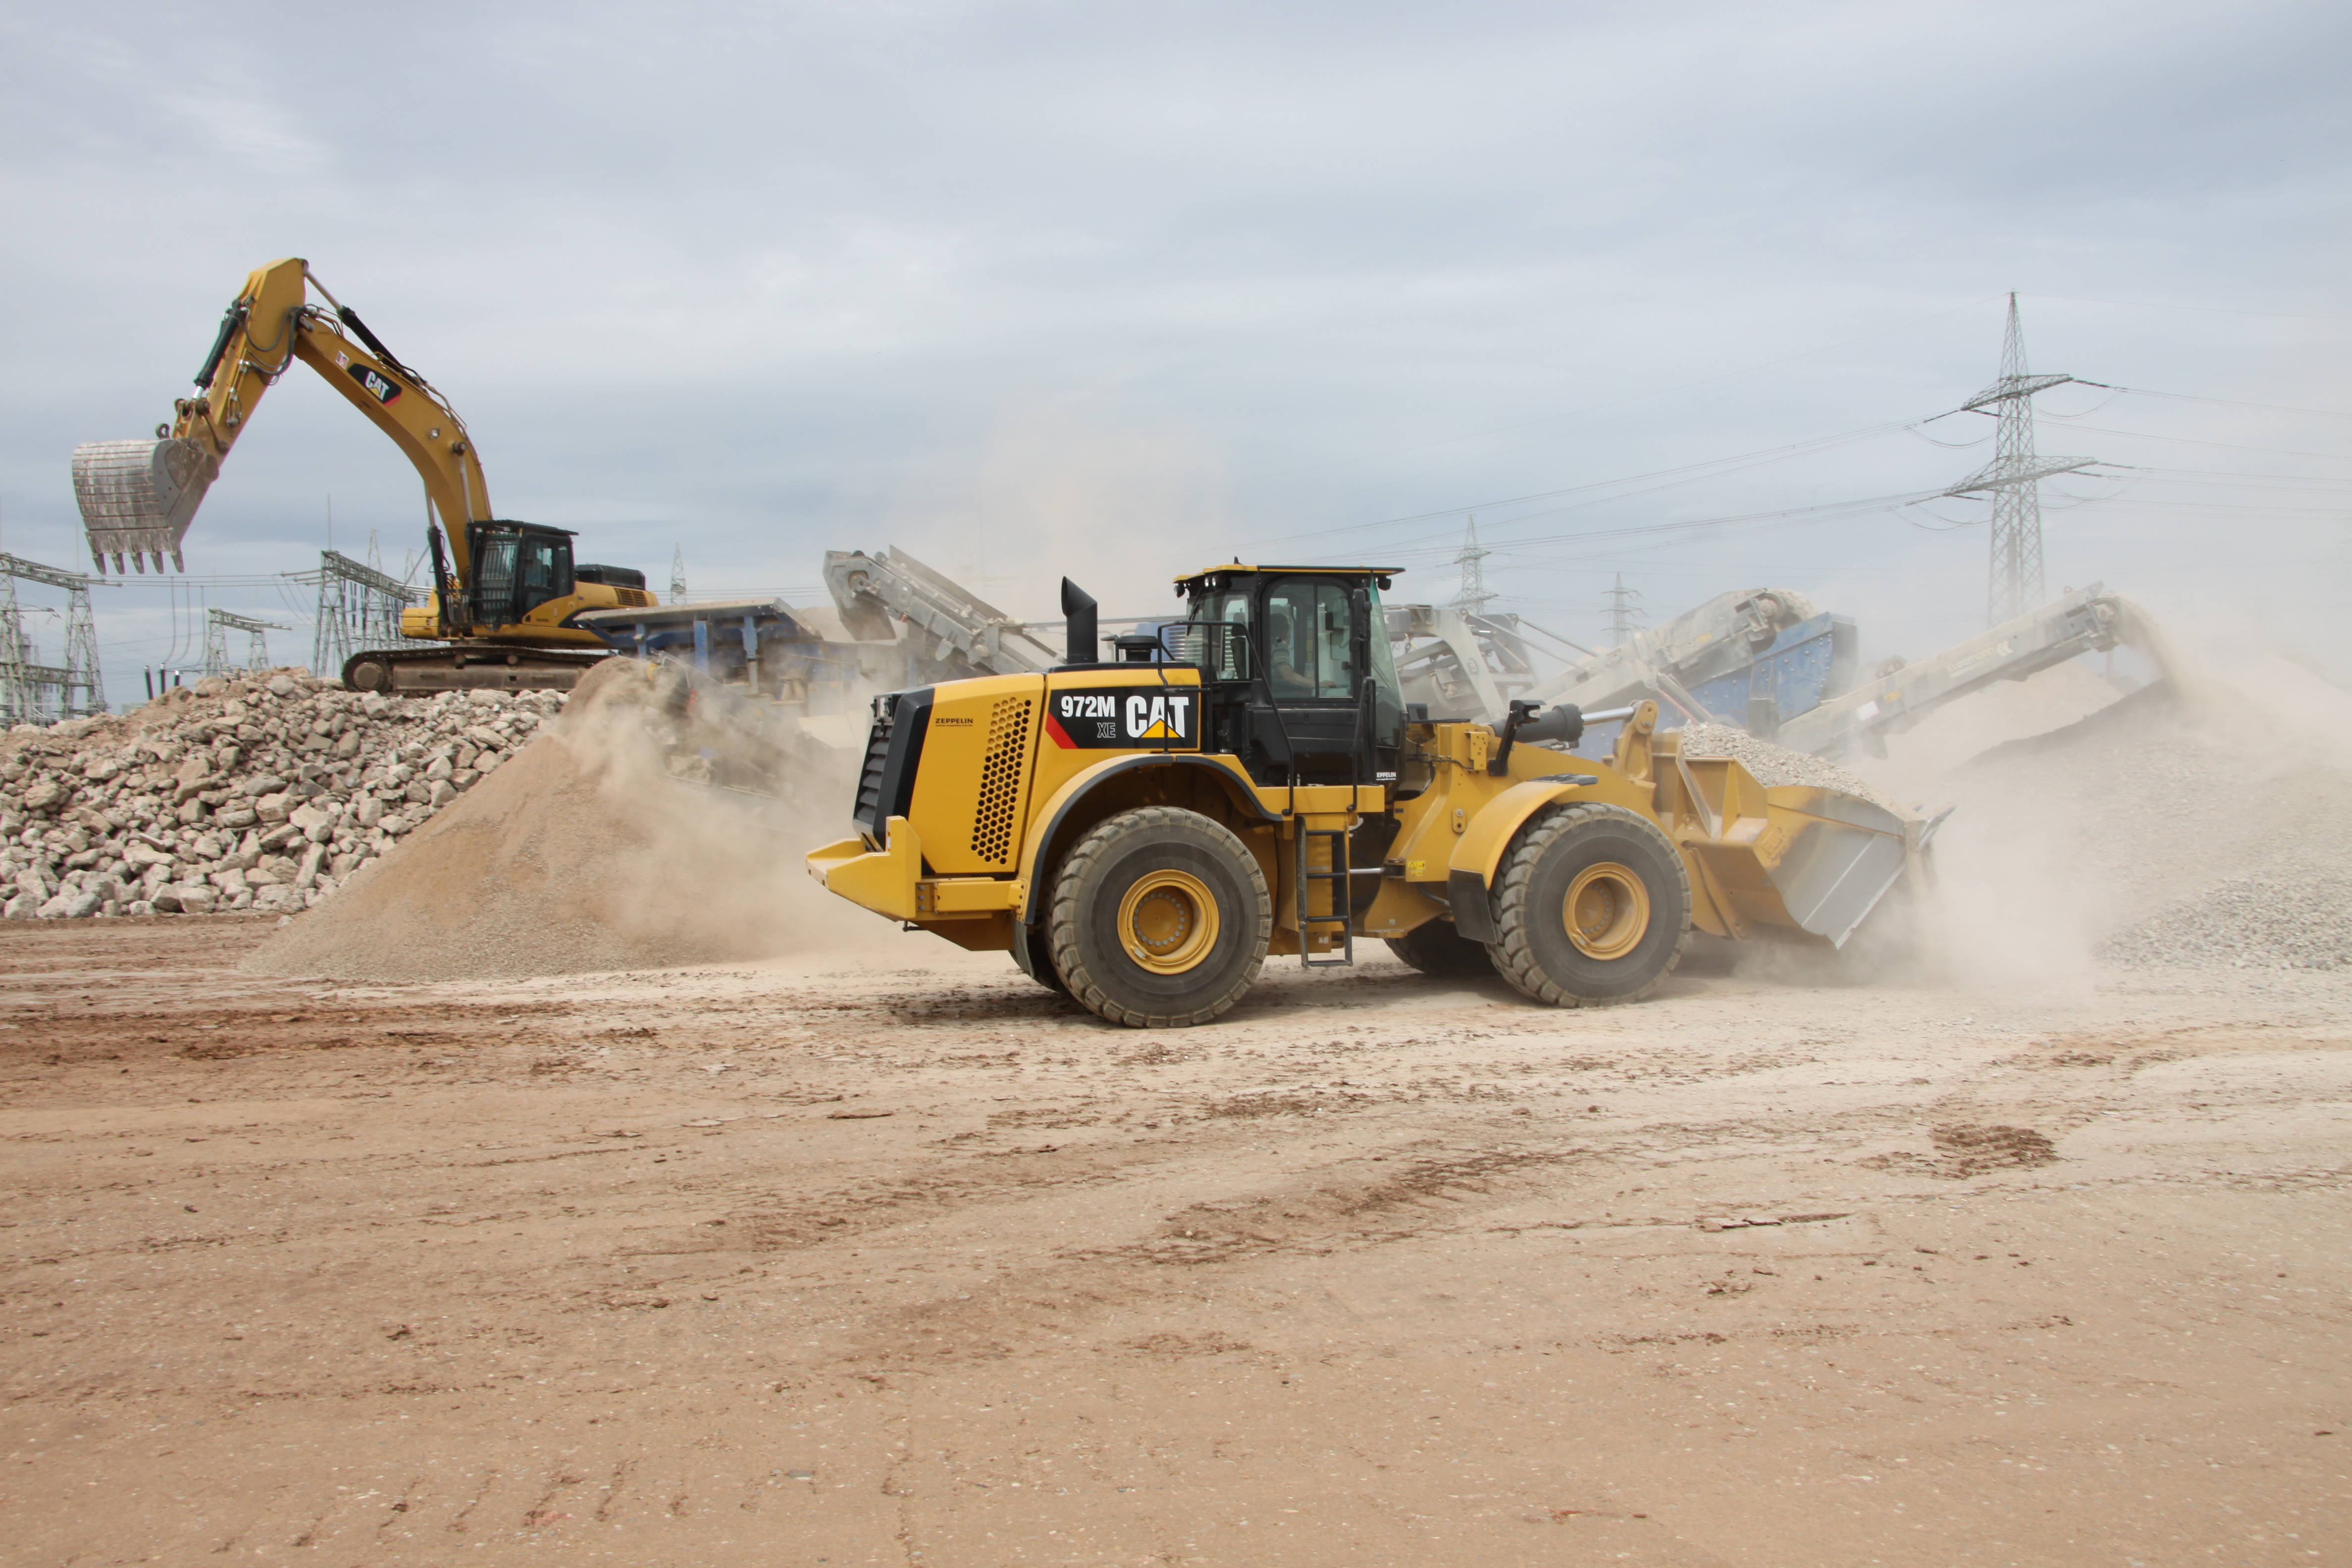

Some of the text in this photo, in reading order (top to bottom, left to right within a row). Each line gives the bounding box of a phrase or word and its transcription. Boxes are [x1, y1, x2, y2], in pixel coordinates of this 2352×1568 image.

[365, 371, 390, 401] CAT
[1061, 695, 1189, 737] 972M CAT
[1097, 722, 1116, 738] XE
